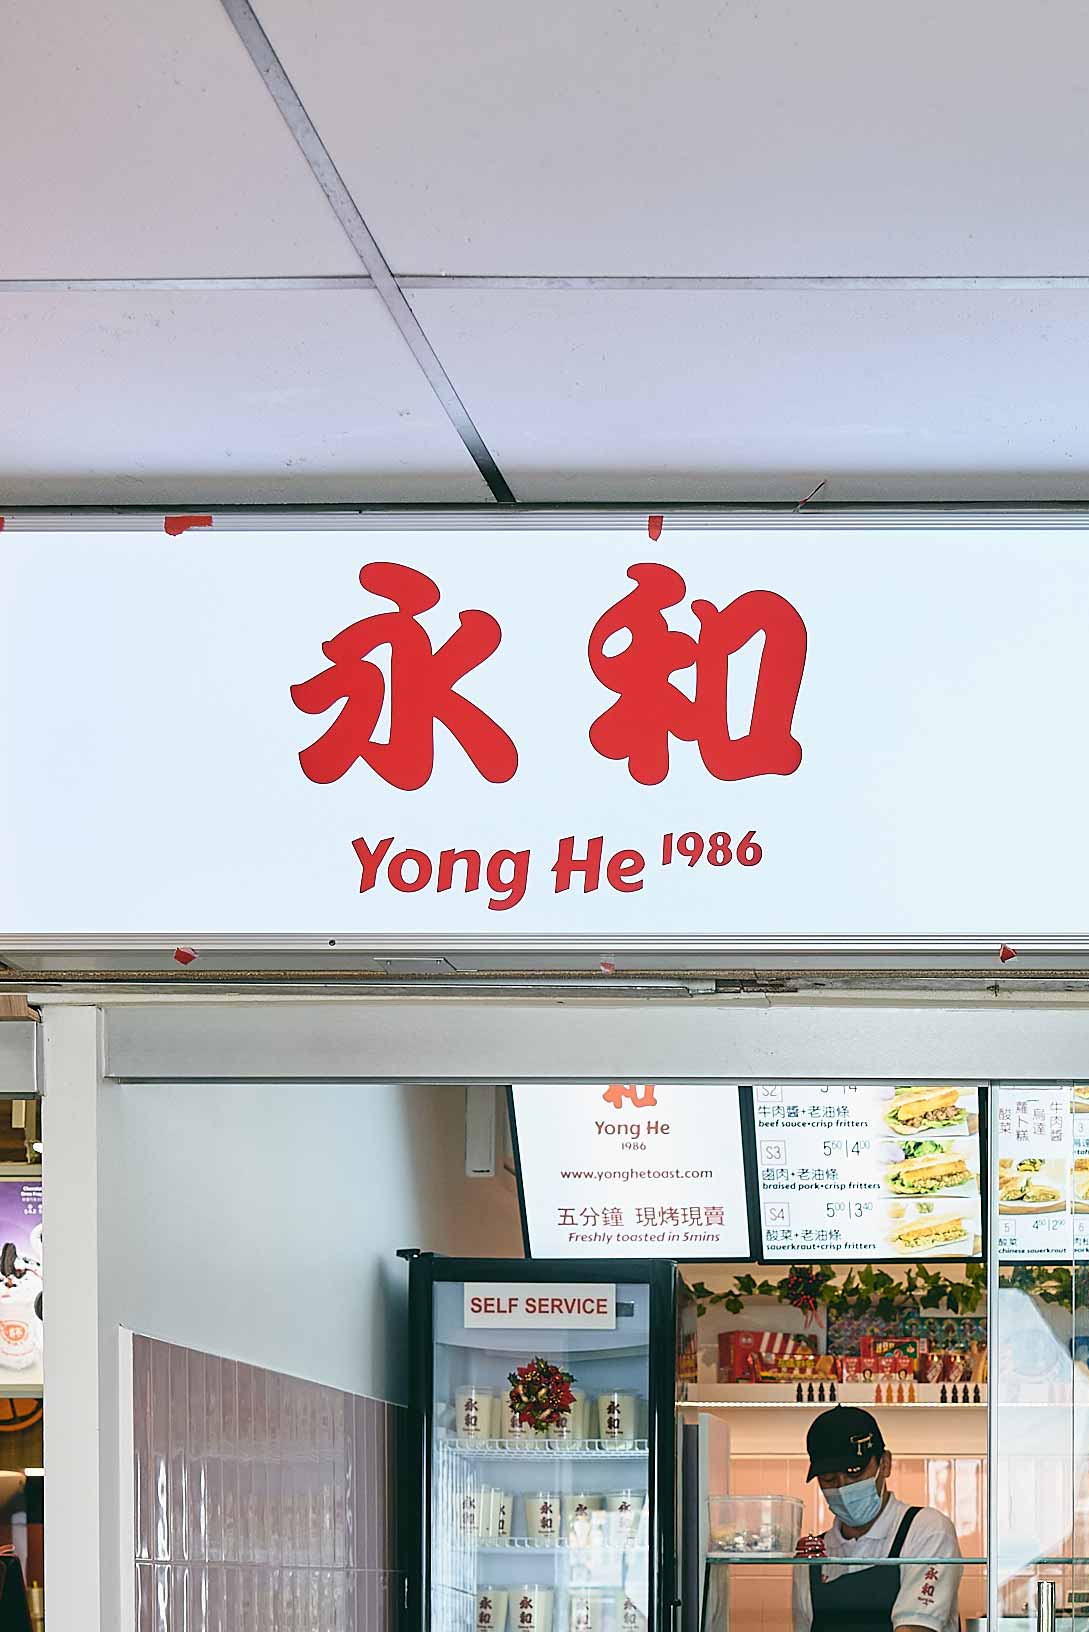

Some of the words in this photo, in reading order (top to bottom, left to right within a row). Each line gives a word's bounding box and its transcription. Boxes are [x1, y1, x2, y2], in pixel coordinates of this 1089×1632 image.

[290, 562, 808, 790] 永和
[351, 836, 531, 910] Yong
[551, 836, 646, 894] He
[661, 830, 764, 867] 1986
[595, 1121, 641, 1139] Yong
[647, 1121, 670, 1135] He
[836, 1120, 869, 1128] fritters
[621, 1142, 647, 1151] 1986
[765, 1145, 781, 1160] S3
[561, 1168, 713, 1182] www.yonghetoast.com
[557, 1207, 625, 1227] 五分鐘
[635, 1206, 725, 1227] 現烤現賣
[769, 1207, 785, 1221] S4
[568, 1232, 612, 1244] Freshly
[616, 1232, 665, 1242] toasted
[667, 1232, 679, 1242] in
[682, 1232, 720, 1242] 5mins
[470, 1297, 519, 1314] SELF
[525, 1298, 608, 1314] SERVICE
[922, 1567, 939, 1597] 永和
